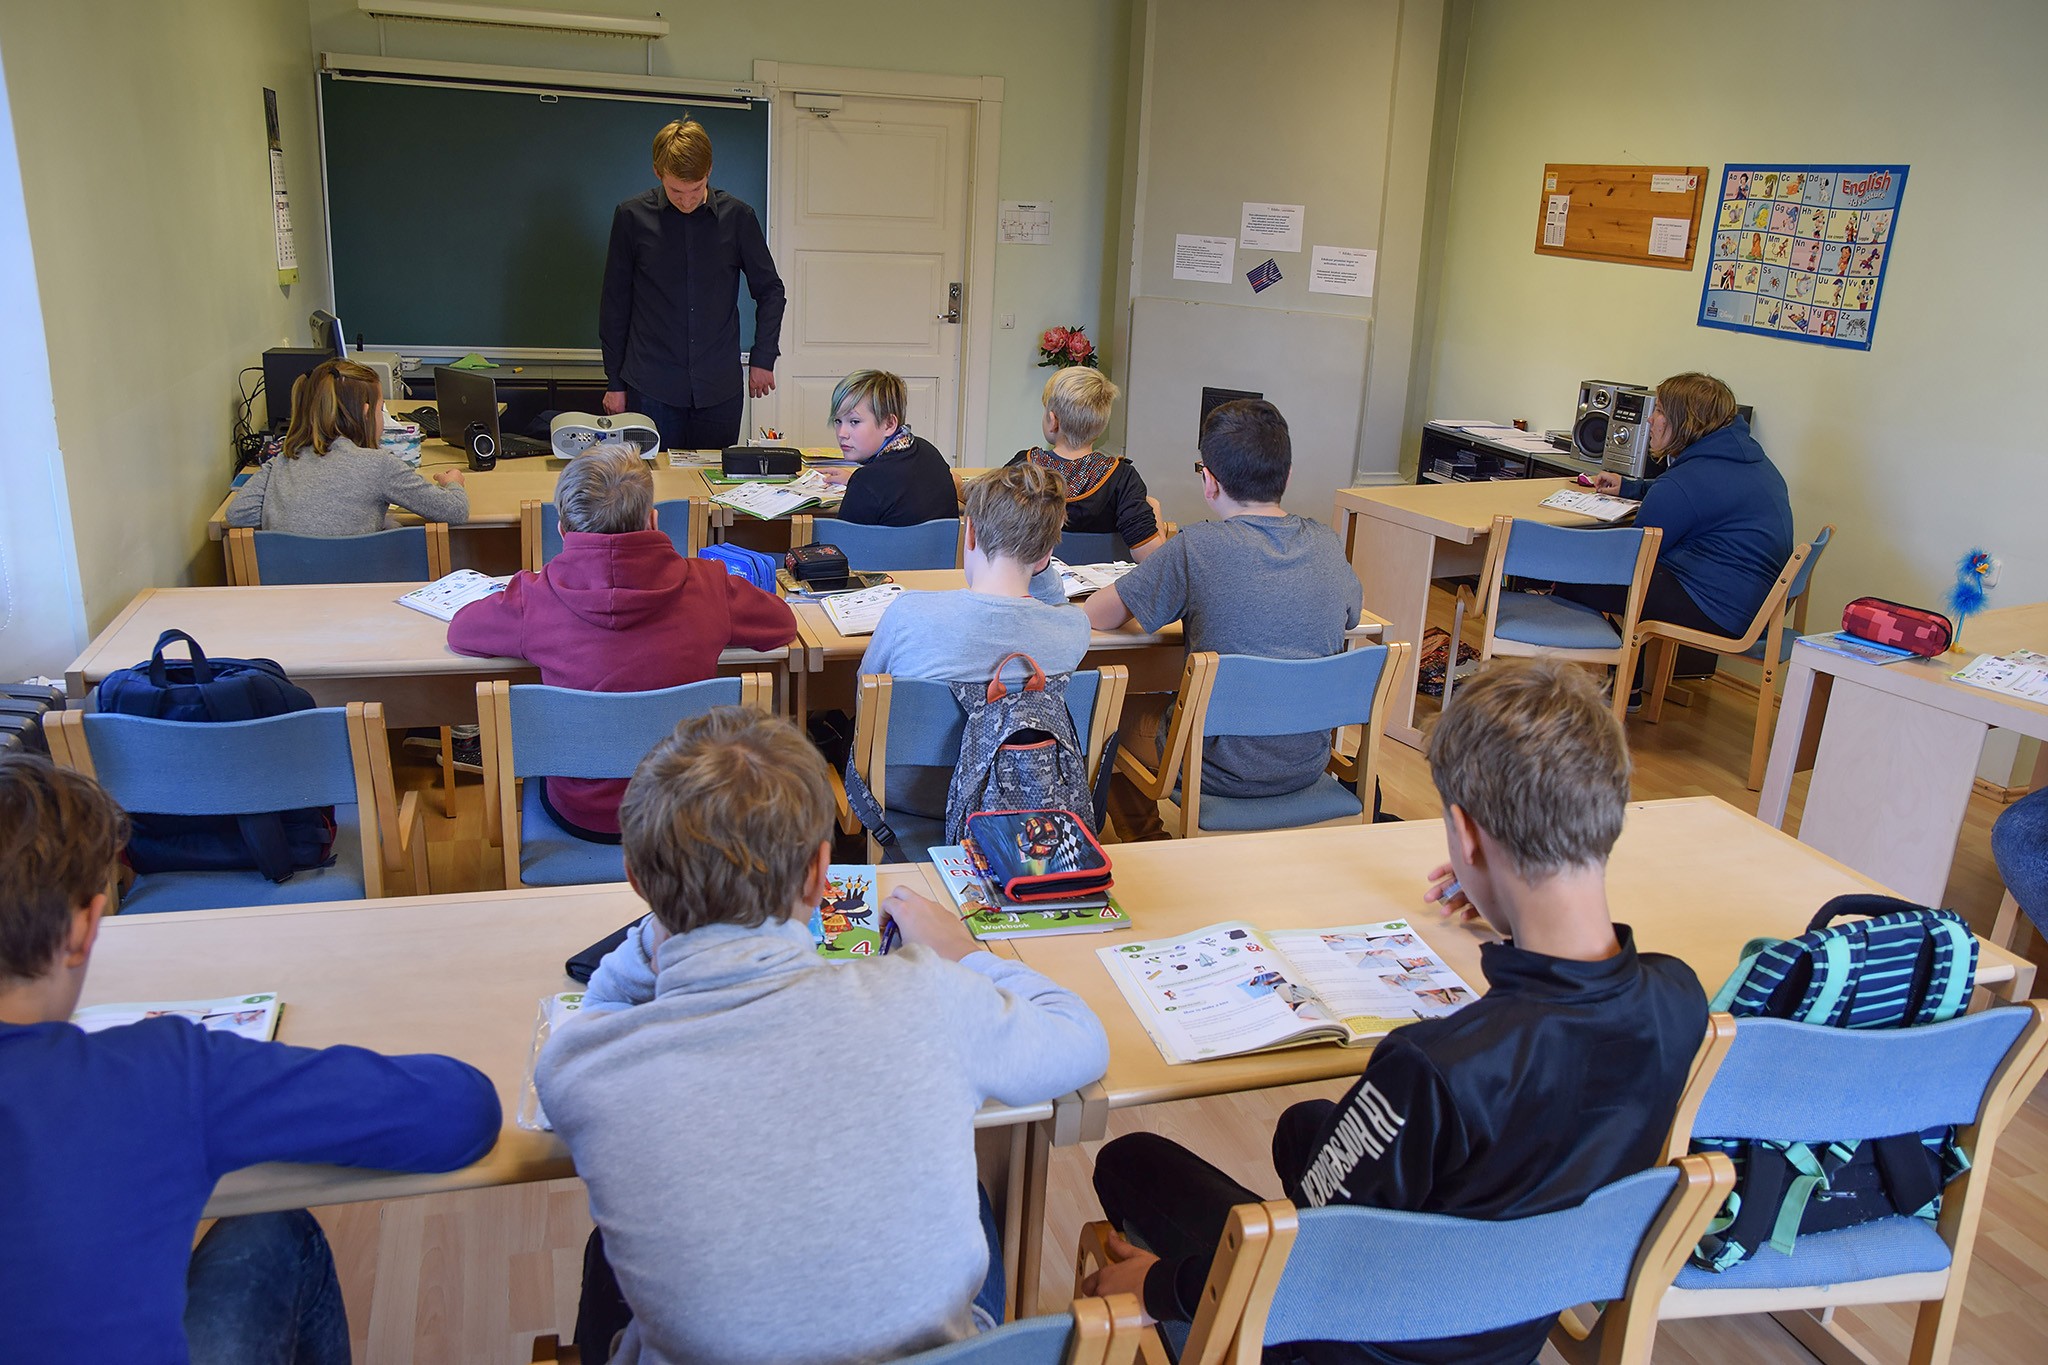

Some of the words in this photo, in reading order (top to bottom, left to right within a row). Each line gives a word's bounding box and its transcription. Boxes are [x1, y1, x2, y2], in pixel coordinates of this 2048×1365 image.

[1781, 174, 1791, 182] Cc
[1809, 174, 1819, 182] Dd
[1842, 170, 1892, 197] English
[1723, 203, 1732, 211] Ee
[1747, 201, 1756, 209] Ff
[1775, 204, 1785, 213] Gg
[1802, 207, 1812, 215] Hh
[1862, 213, 1870, 222] Jj
[1717, 233, 1726, 241] Kk
[1768, 235, 1781, 243] Mm
[1794, 239, 1806, 247] Nn
[1825, 244, 1836, 252] Oo
[1856, 246, 1866, 255] Pp
[1713, 263, 1722, 272] Qq
[1790, 271, 1797, 279] Tt
[1848, 279, 1858, 287] Vv
[1758, 297, 1770, 305] Ww
[1783, 302, 1793, 311] Xx
[1812, 308, 1822, 318] Yy
[1840, 312, 1850, 320] Zz
[1100, 906, 1121, 919] 4
[980, 922, 1030, 931] Workbook
[851, 940, 874, 955] 4
[1354, 1080, 1406, 1144] LH
